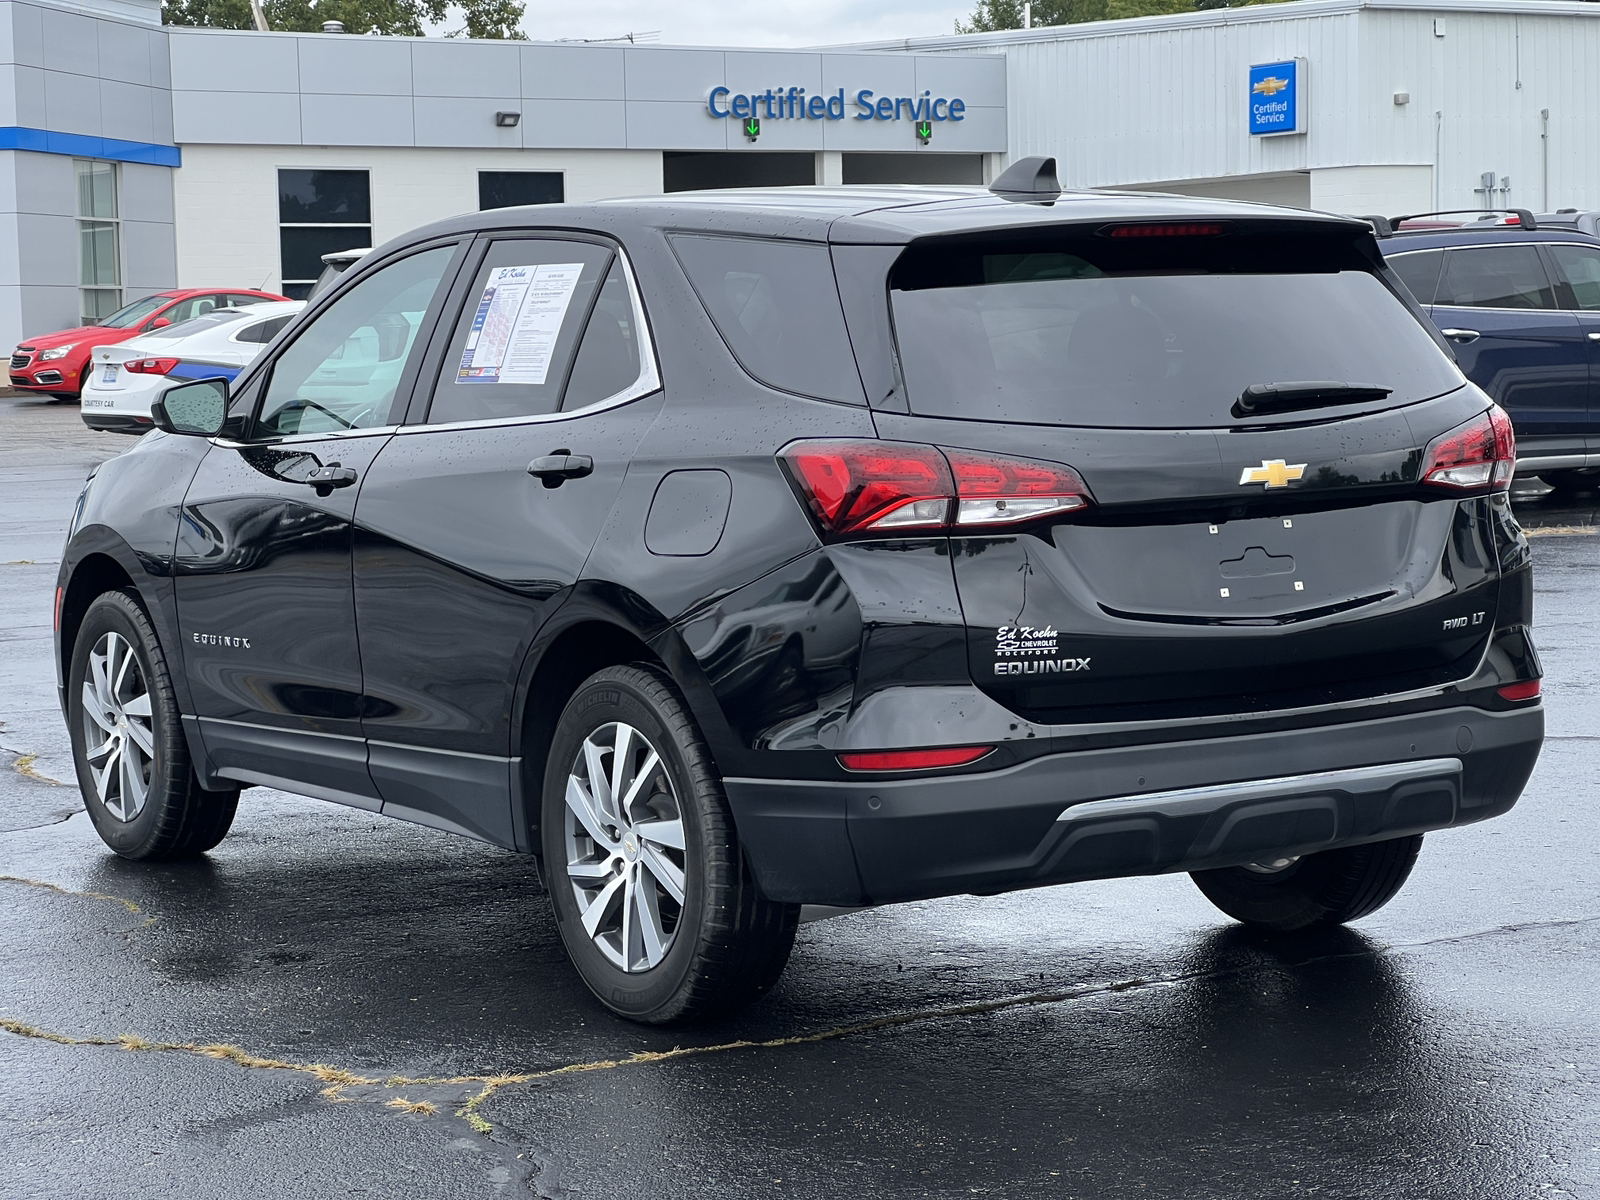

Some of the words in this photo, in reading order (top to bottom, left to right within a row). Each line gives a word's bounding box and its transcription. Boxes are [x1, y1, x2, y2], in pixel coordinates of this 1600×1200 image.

[707, 86, 845, 120] Certified
[856, 90, 966, 121] Service
[1253, 100, 1288, 114] Certified
[1255, 112, 1285, 124] Service
[104, 400, 115, 408] CAR
[1442, 616, 1468, 631] AWD
[1471, 611, 1486, 626] LT
[996, 626, 1017, 640] Ed
[1020, 625, 1058, 640] Koehn
[193, 632, 251, 649] EQUINOX
[1021, 640, 1057, 648] CHEVROLET
[997, 649, 1056, 657] ROCKFORD
[994, 658, 1091, 675] EQUINOX
[576, 690, 619, 715] MICHELIN
